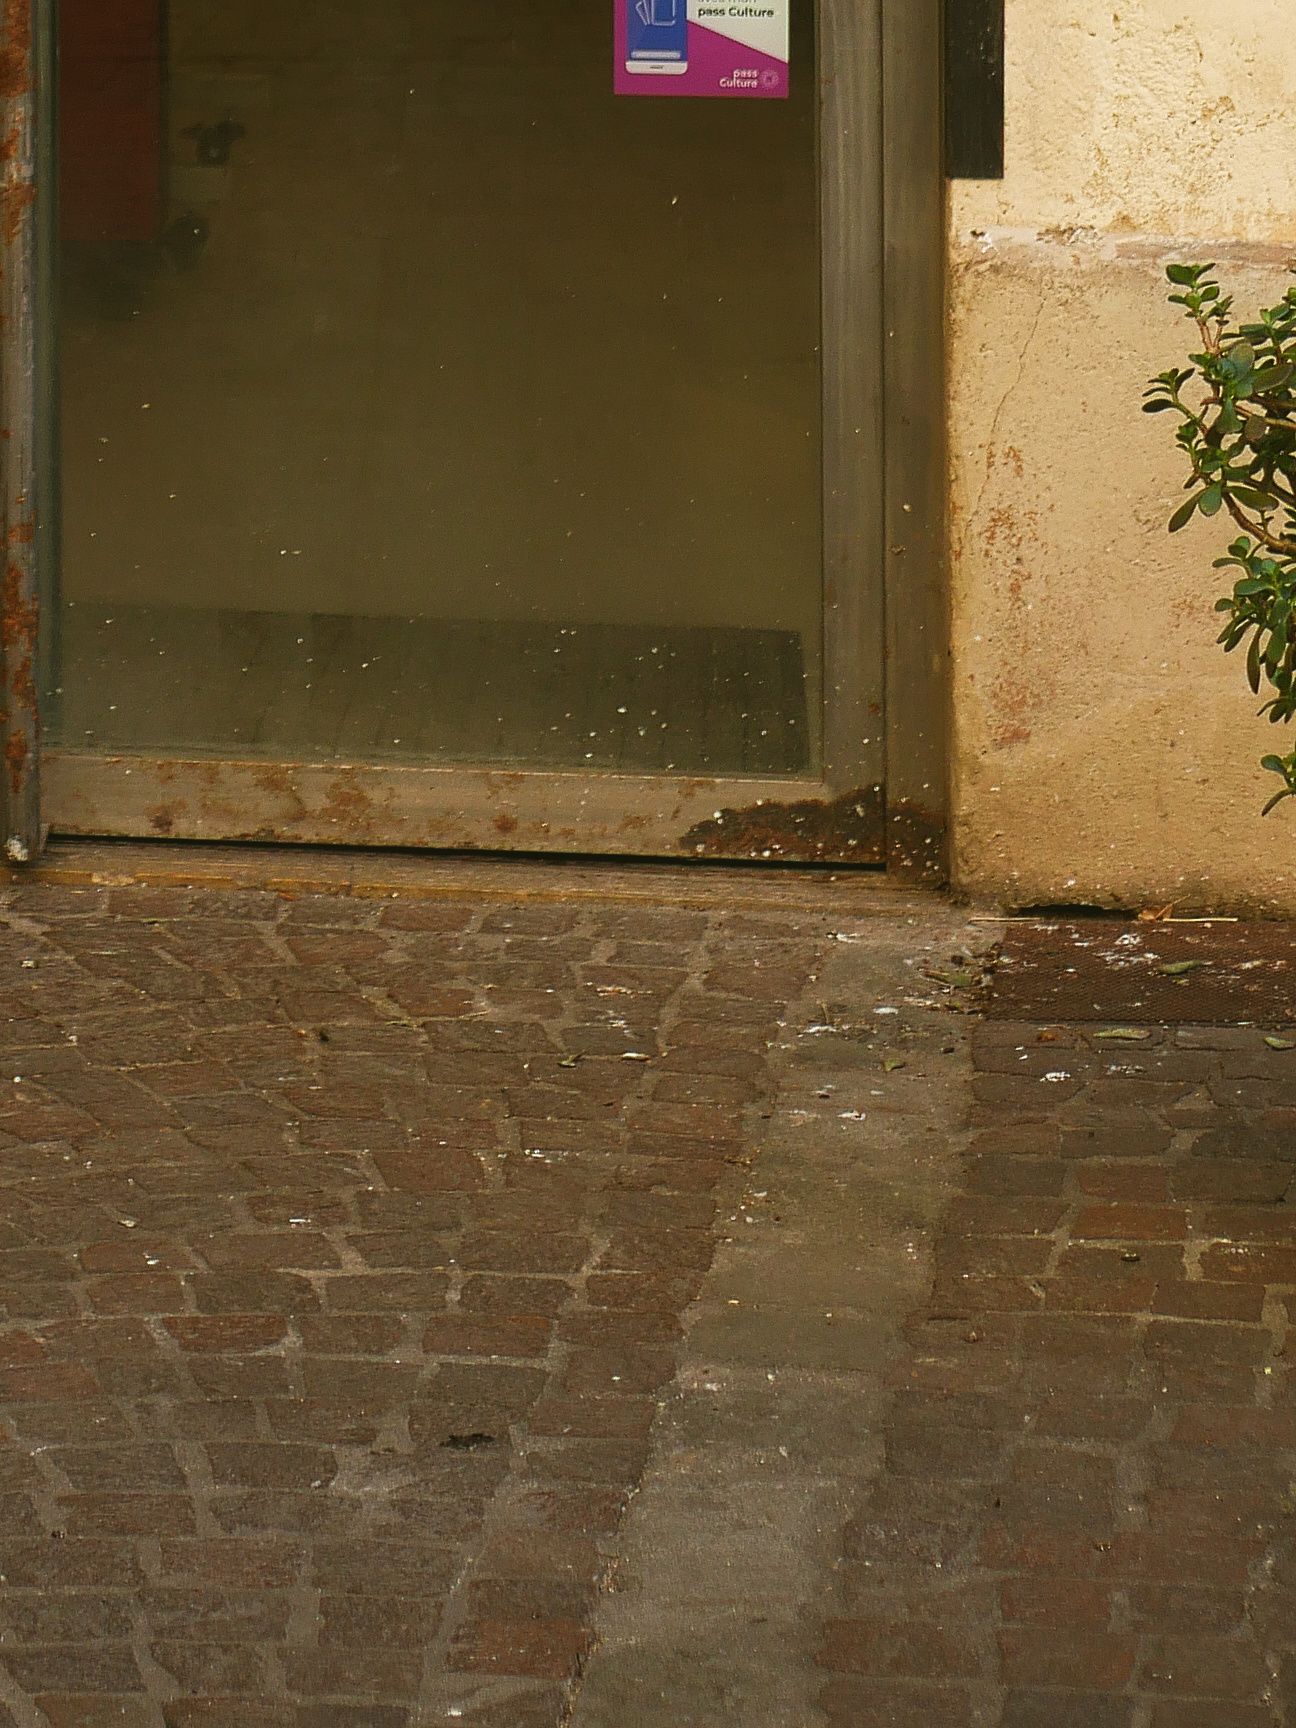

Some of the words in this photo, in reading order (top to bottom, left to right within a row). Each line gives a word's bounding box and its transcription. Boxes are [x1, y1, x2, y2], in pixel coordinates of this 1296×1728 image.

[698, 8, 725, 19] pass
[726, 6, 775, 18] Culture
[733, 68, 758, 79] pass
[719, 76, 758, 88] Culture
